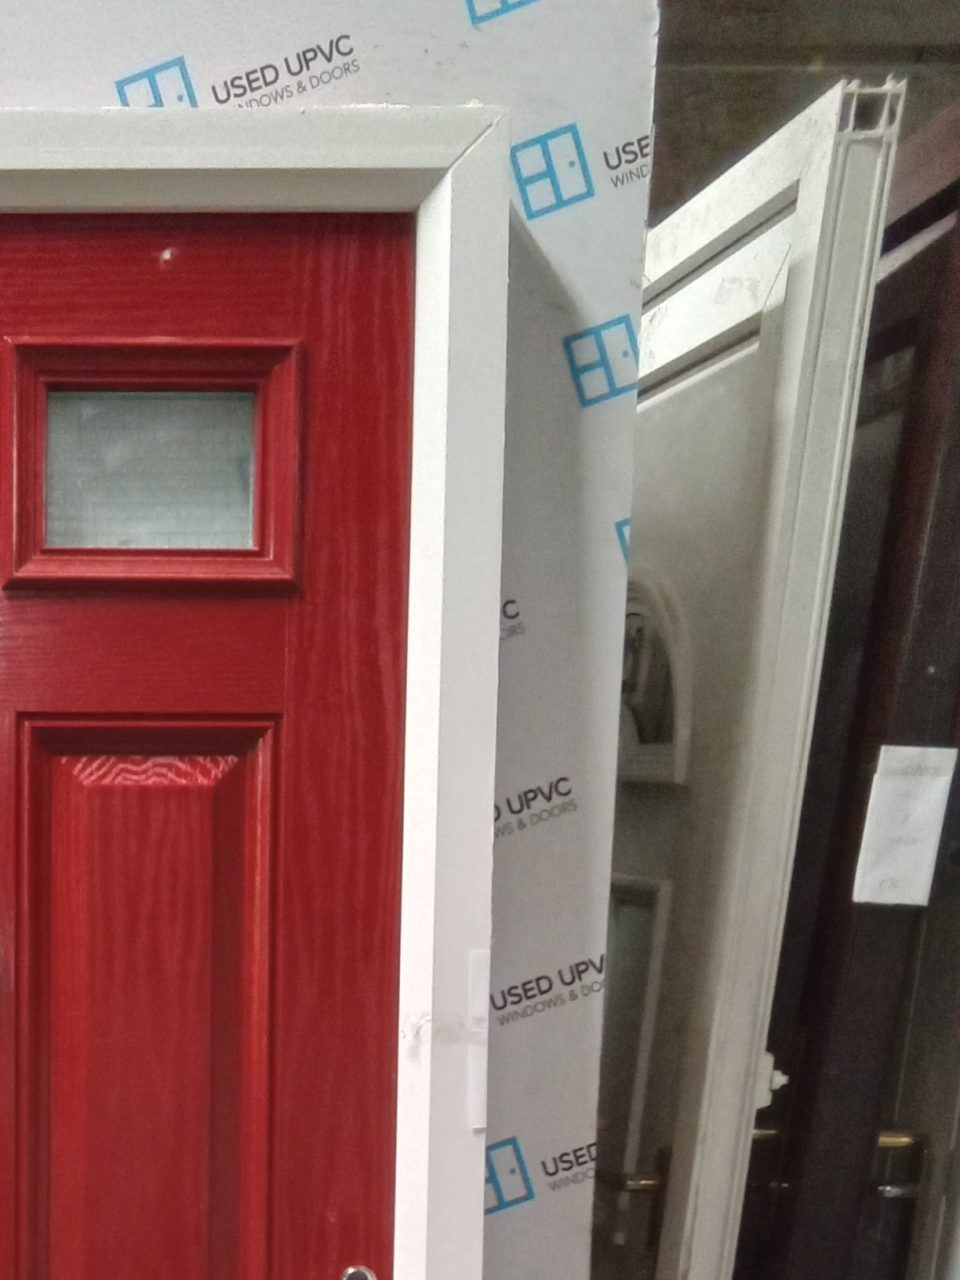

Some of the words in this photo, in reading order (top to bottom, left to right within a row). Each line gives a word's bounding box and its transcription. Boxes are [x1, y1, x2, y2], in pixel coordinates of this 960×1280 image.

[211, 63, 280, 105] USED
[284, 34, 354, 76] UPVC
[296, 80, 308, 95] &
[309, 58, 361, 90] DOORS
[603, 135, 650, 171] USE
[610, 164, 650, 189] WIND
[506, 777, 572, 815] UPVC
[530, 798, 578, 827] DOORS
[490, 974, 553, 1011] USED
[557, 954, 604, 986] UPV
[496, 991, 567, 1027] WINDOWS
[548, 1167, 597, 1192] WINDO
